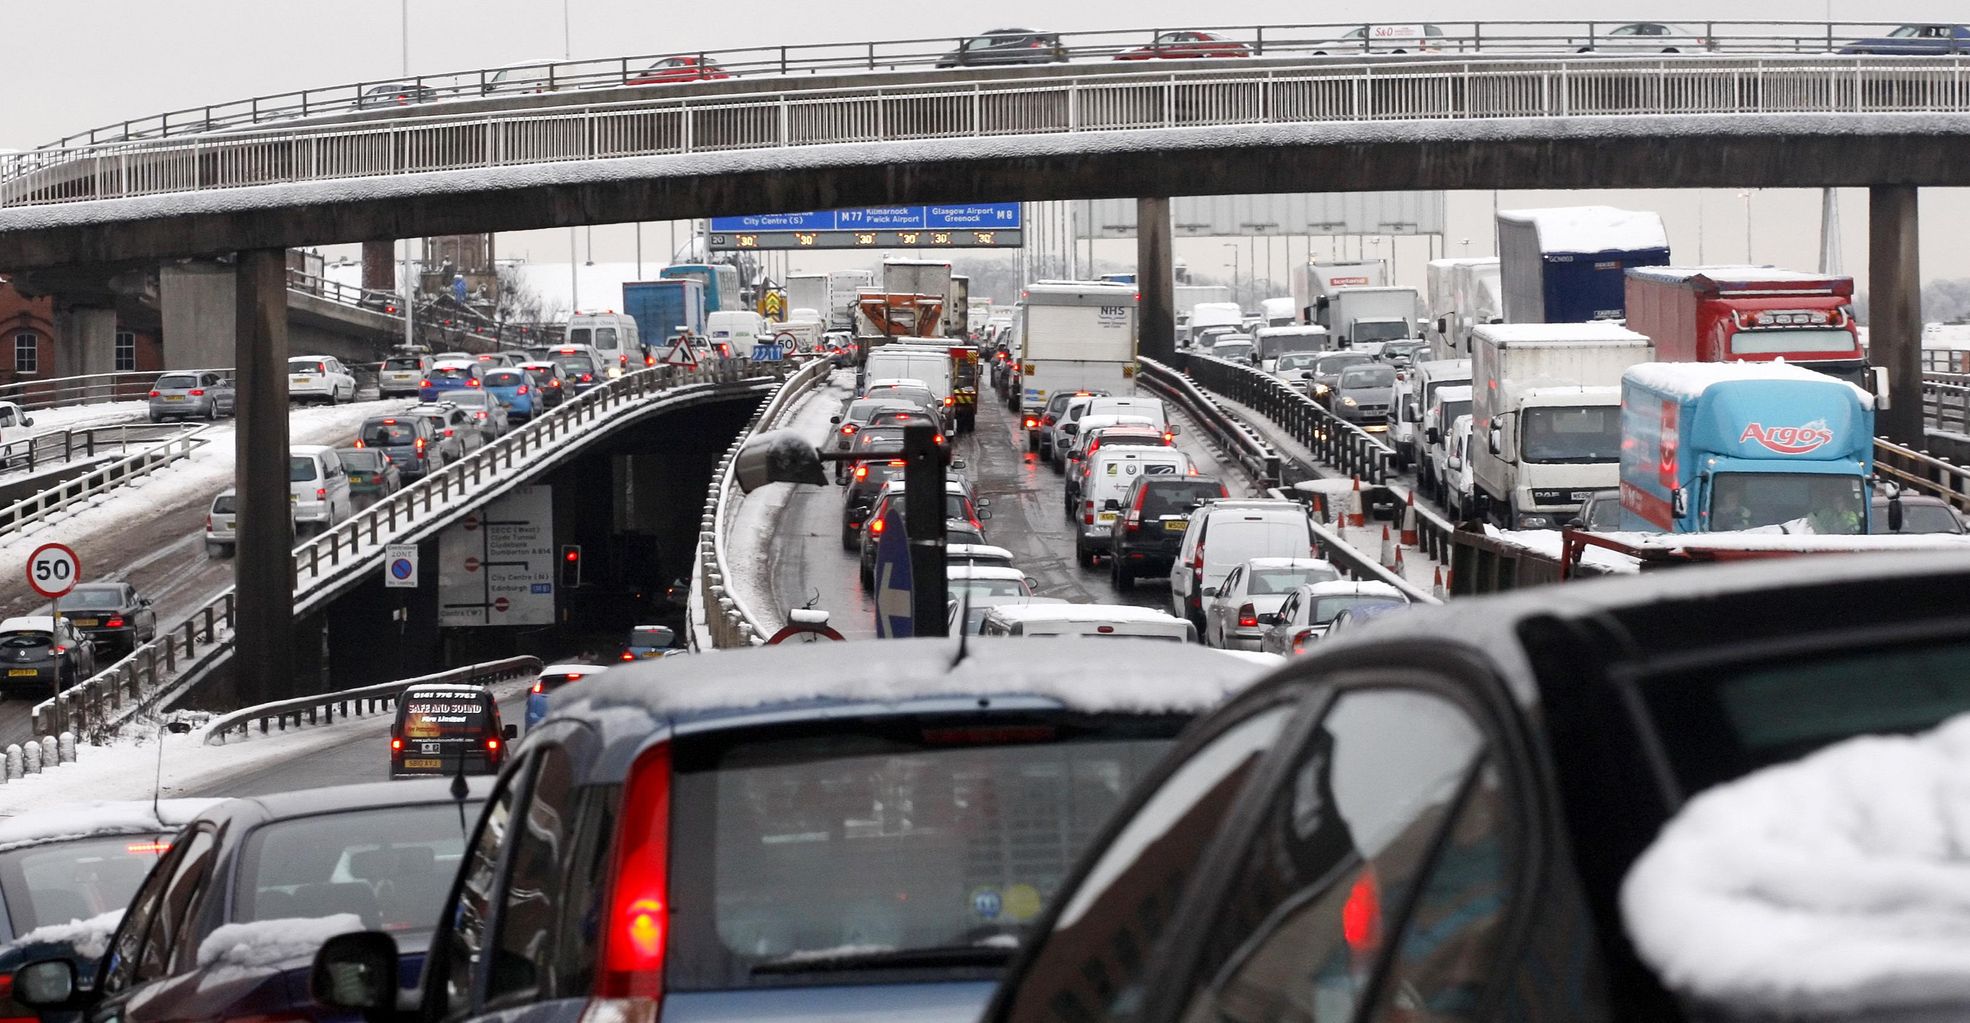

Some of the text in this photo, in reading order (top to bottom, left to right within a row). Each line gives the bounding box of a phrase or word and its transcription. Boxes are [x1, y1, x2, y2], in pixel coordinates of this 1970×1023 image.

[852, 212, 862, 222] 77
[932, 208, 993, 216] Glasgow Airport
[744, 216, 804, 226] City Centre (S)
[742, 236, 753, 246] 30
[801, 235, 812, 244] 30
[860, 234, 872, 244] 30
[904, 234, 916, 244] 30
[935, 234, 947, 243] 30
[978, 234, 991, 243] 30
[1100, 306, 1124, 315] NHS
[778, 340, 794, 349] 50
[1739, 422, 1834, 447] Argos
[35, 559, 70, 581] 50
[408, 704, 482, 714] SAFE AND SOUND
